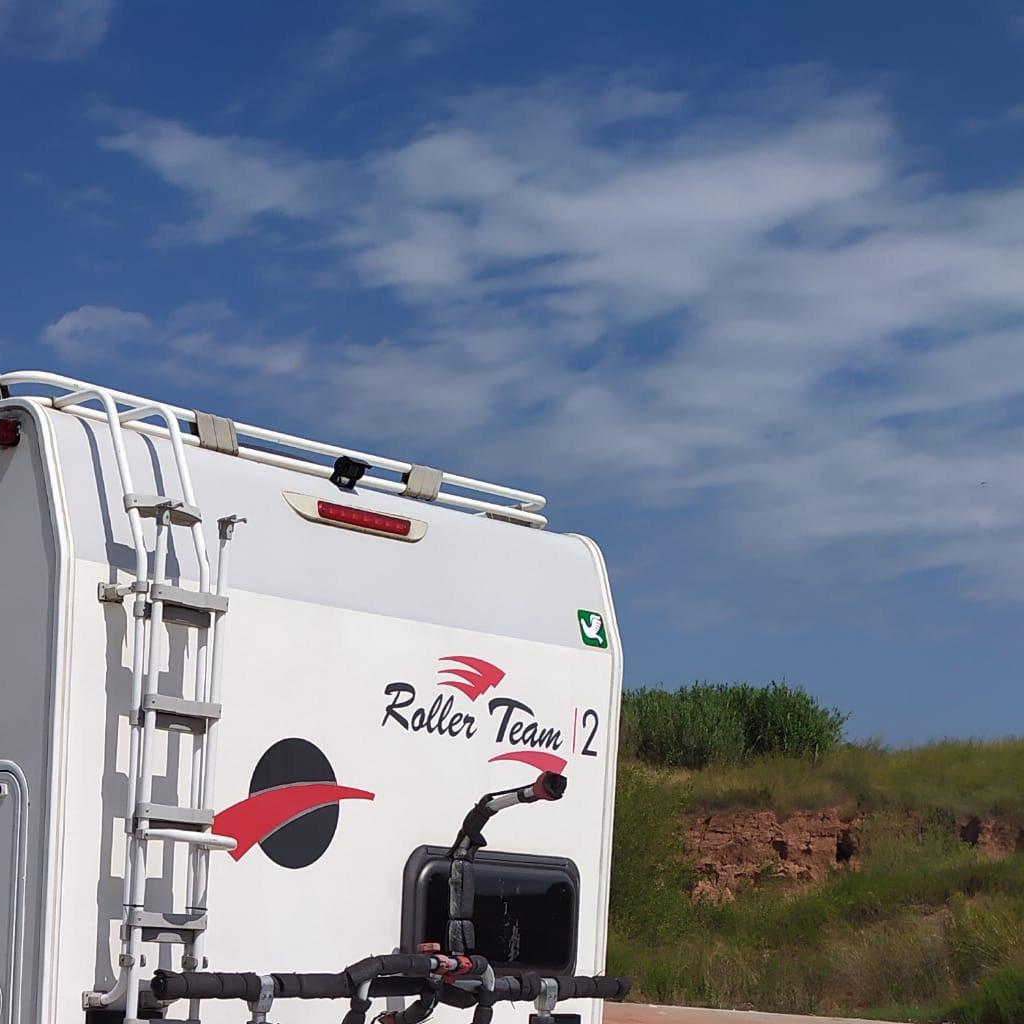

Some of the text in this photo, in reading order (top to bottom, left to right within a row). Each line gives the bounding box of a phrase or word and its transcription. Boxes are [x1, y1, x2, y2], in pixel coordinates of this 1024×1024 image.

[381, 682, 599, 757] Roller Team 2
